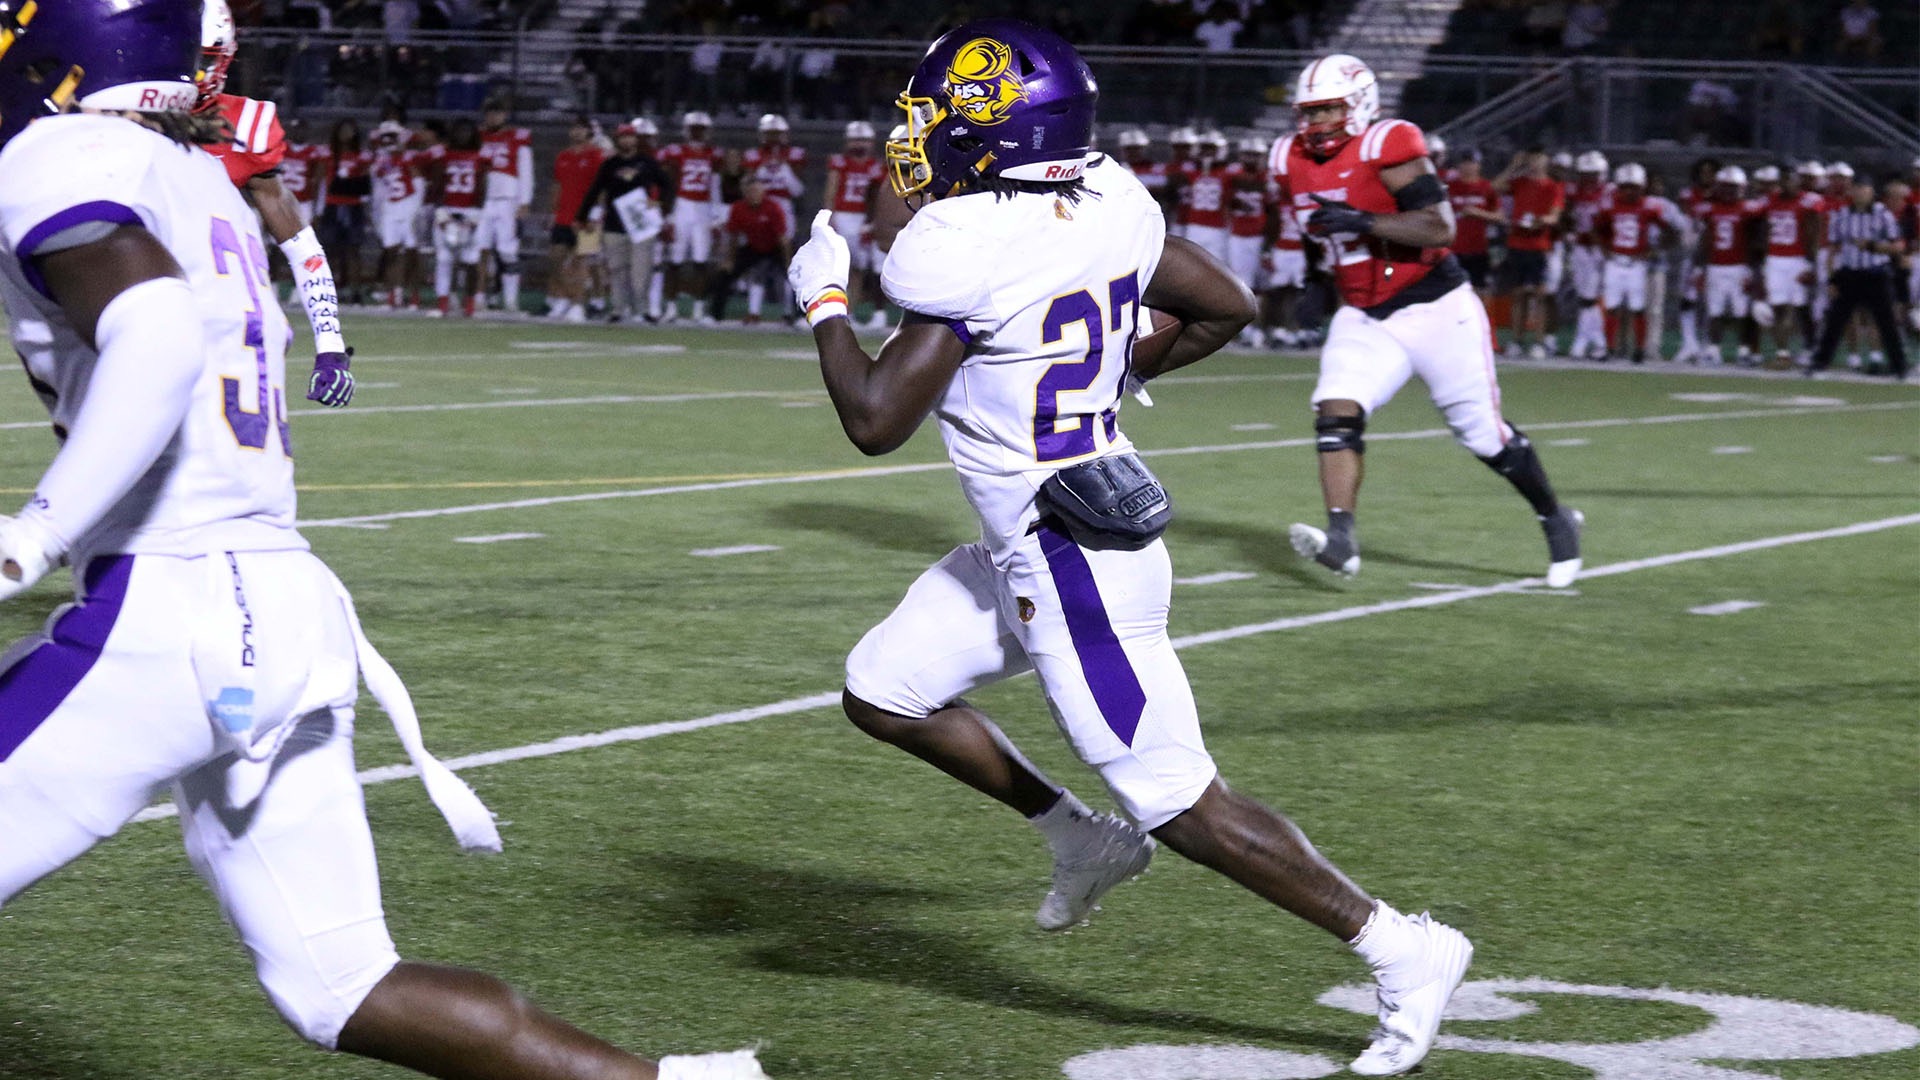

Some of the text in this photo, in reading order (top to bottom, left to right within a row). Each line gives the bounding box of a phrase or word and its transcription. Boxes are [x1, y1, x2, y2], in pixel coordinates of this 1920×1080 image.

[308, 293, 338, 309] ONE
[1031, 268, 1140, 464] 27
[1123, 487, 1161, 514] BATTLE
